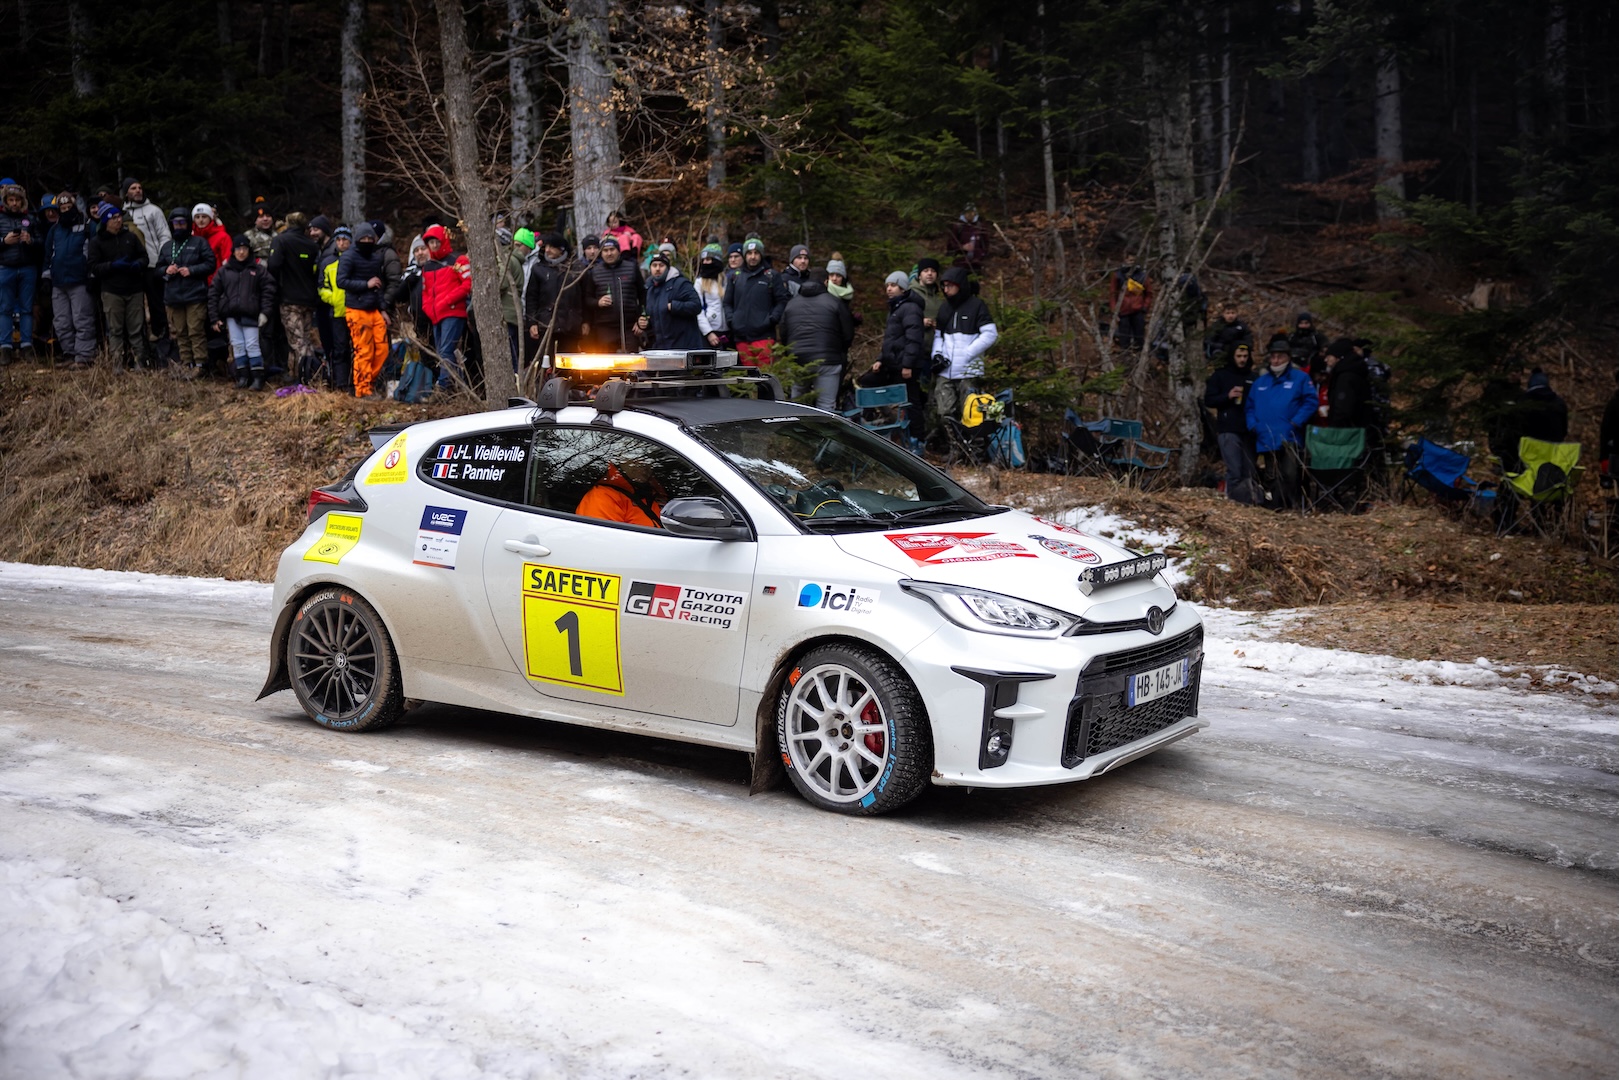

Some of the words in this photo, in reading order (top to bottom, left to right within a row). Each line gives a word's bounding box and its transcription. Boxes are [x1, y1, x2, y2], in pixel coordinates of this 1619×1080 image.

[474, 445, 525, 462] Vieilleville
[447, 464, 459, 478] E.
[462, 464, 506, 481] Pannier
[940, 552, 1017, 564] ORGANISATION
[531, 568, 612, 600] SAFETY
[685, 588, 743, 605] TOYOTA
[820, 585, 856, 611] ici
[855, 595, 874, 604] Radio
[626, 594, 676, 620] GR
[681, 600, 736, 616] GAZOO
[851, 606, 872, 615] Digital
[678, 610, 732, 629] Racing
[554, 610, 583, 677] 1
[1136, 662, 1182, 699] HB-145-JA
[889, 719, 897, 751] winter
